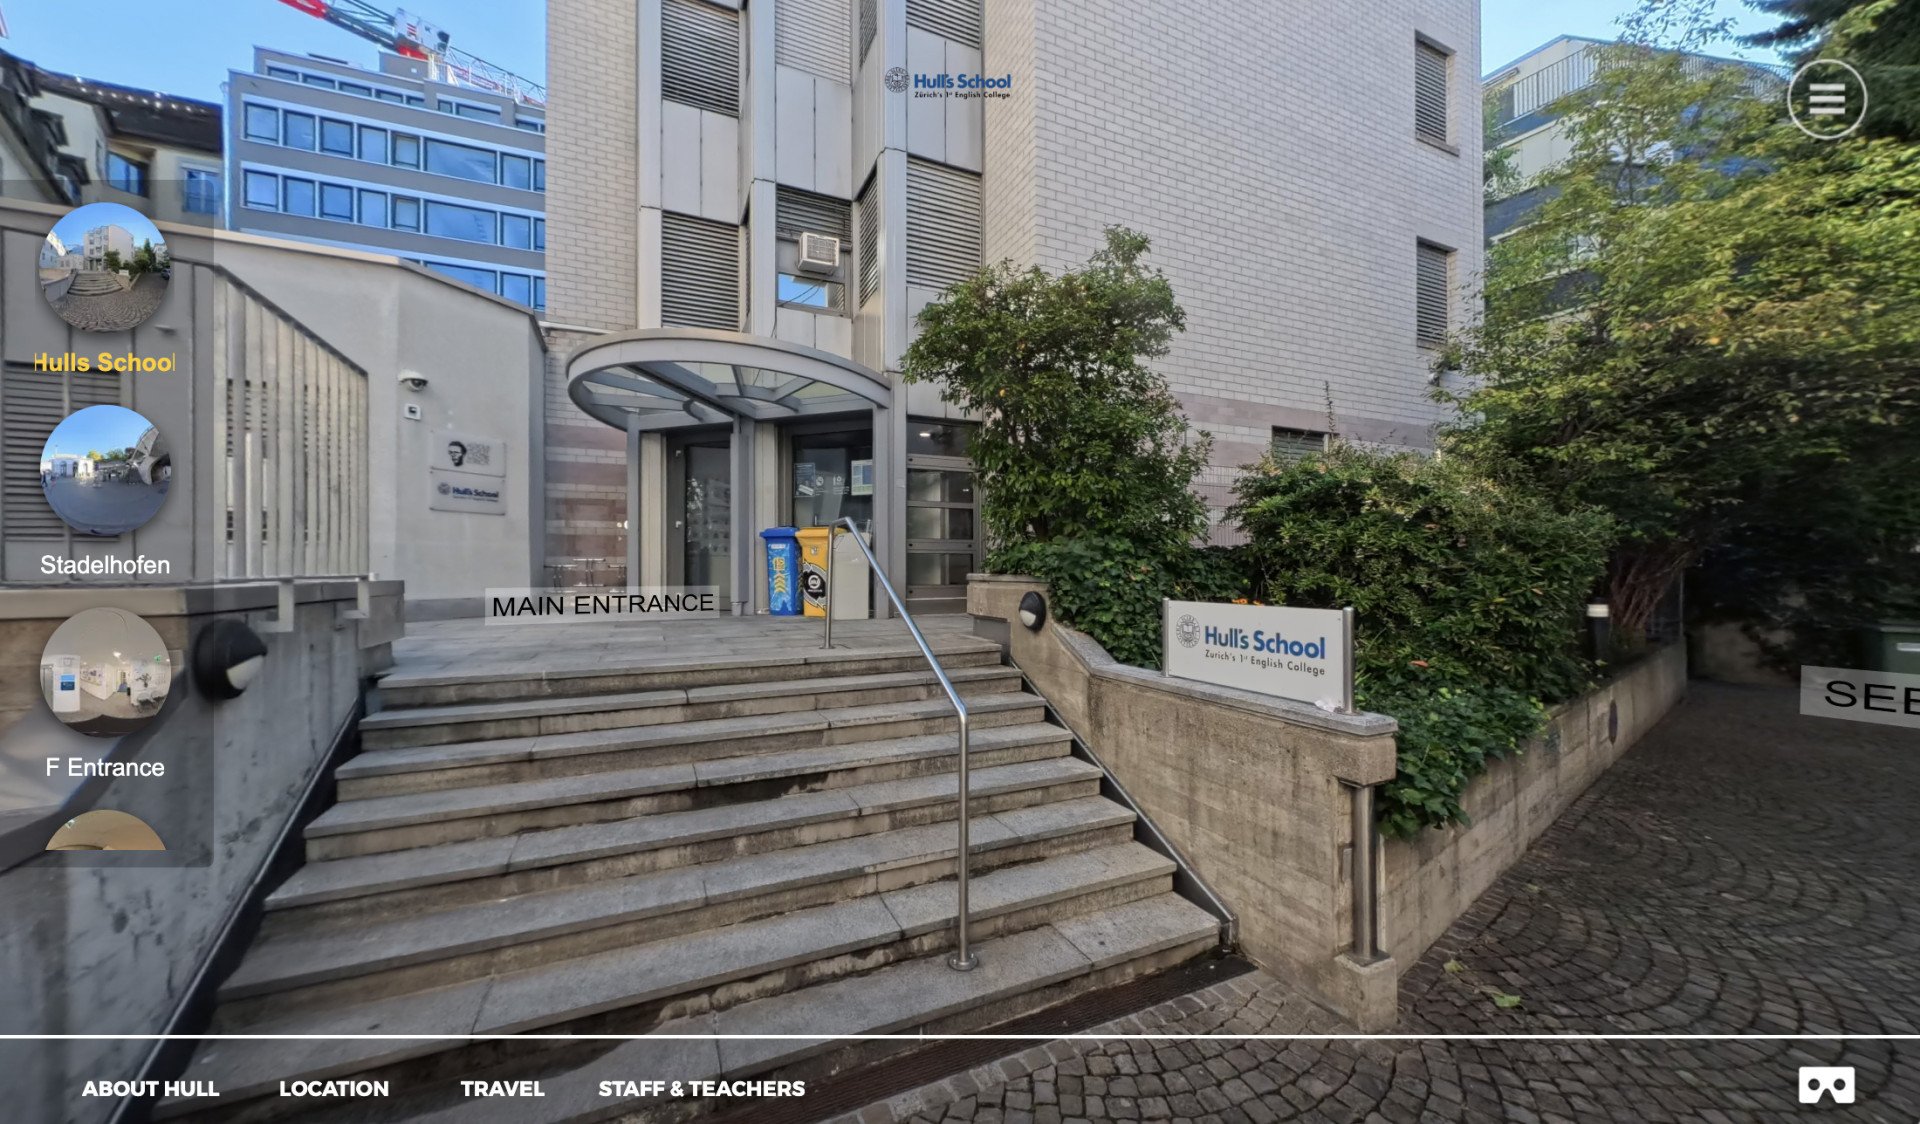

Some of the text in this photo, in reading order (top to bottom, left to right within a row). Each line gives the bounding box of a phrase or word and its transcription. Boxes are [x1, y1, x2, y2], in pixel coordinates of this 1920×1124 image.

[1204, 625, 1249, 650] Hull's
[1253, 629, 1326, 660] School
[1250, 655, 1283, 669] English
[1287, 660, 1325, 677] College
